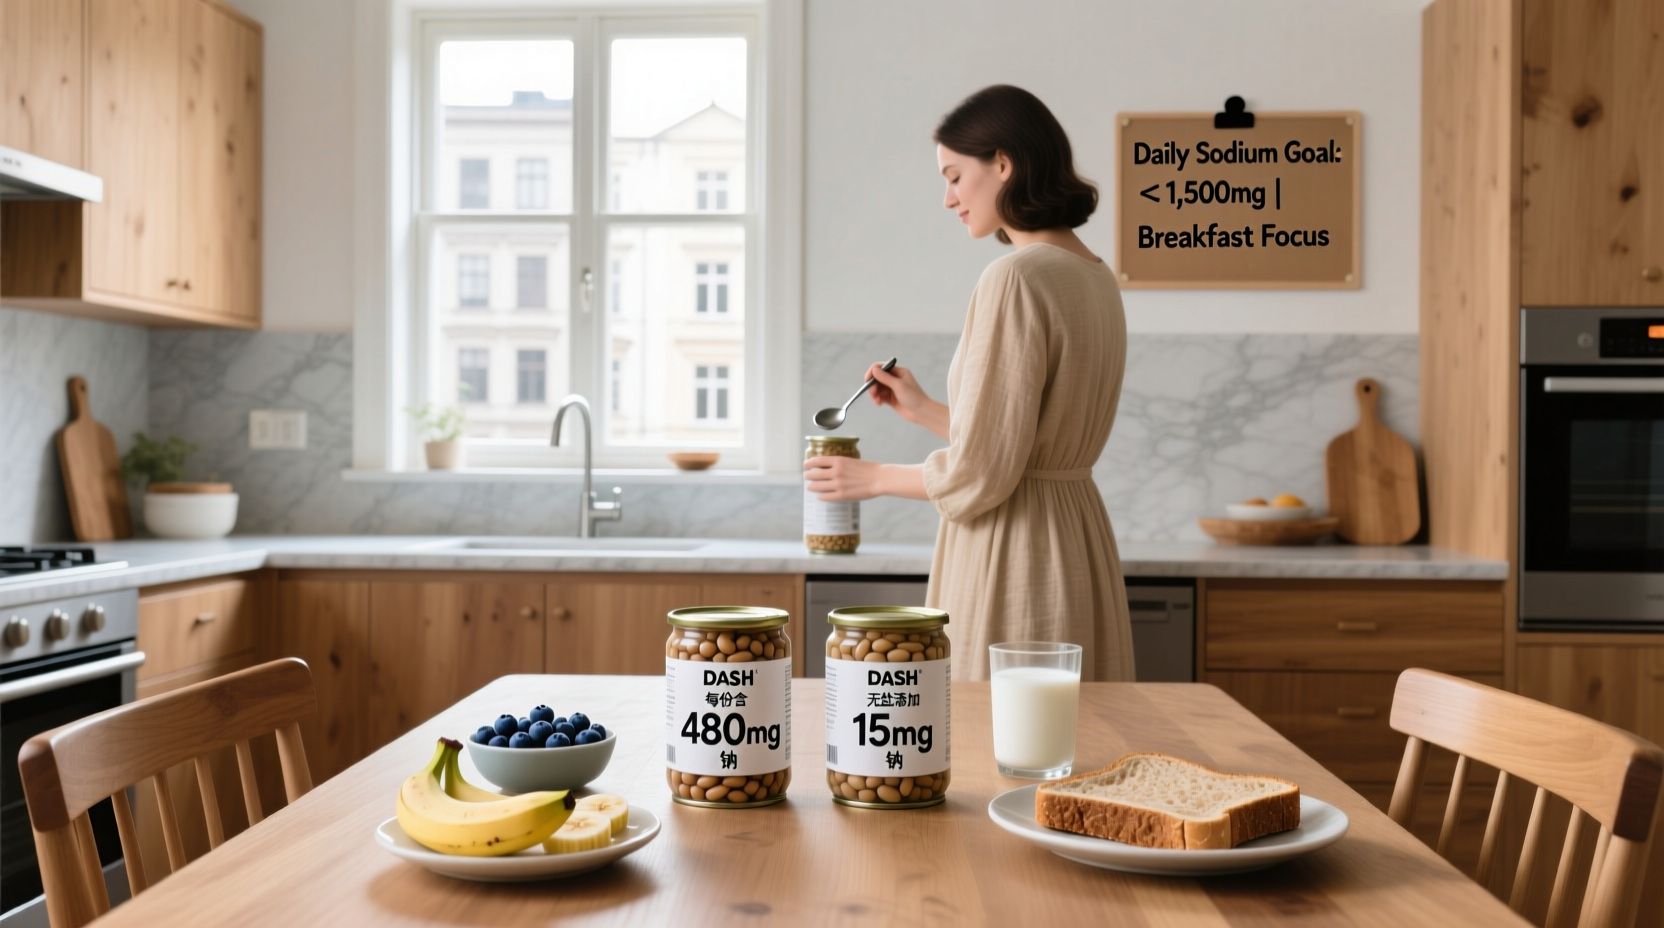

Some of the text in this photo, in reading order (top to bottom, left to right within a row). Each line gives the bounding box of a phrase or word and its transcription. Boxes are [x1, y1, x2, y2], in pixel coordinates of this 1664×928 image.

[1134, 138, 1342, 172] Daily Sodium Goal:
[1138, 222, 1330, 249] Breakfast Focus
[703, 669, 754, 687] DASH
[867, 669, 919, 687] DASH
[680, 711, 781, 750] 480mg
[852, 712, 933, 753] 15mg
